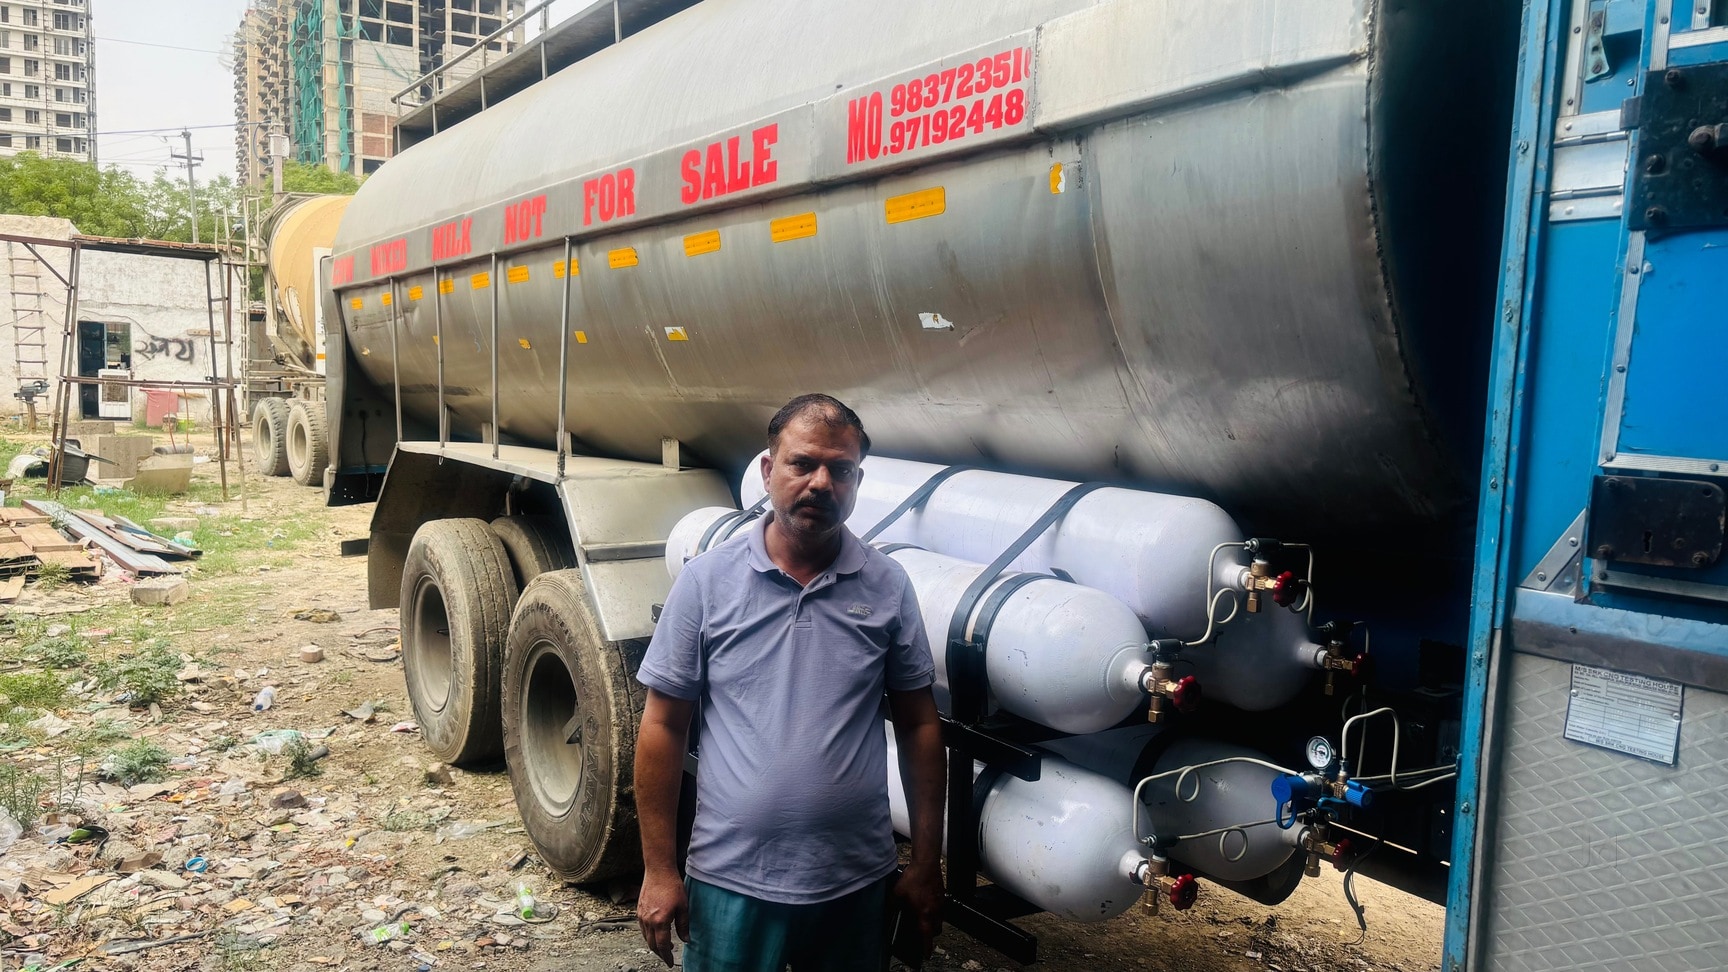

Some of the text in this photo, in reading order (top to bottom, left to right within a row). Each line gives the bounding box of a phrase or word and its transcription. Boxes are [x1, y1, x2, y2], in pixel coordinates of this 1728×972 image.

[847, 91, 889, 165] MO.
[890, 88, 1030, 155] 97192448
[370, 238, 407, 277] MIXED
[432, 217, 472, 262] MILK
[504, 196, 547, 246] NOT
[583, 167, 636, 226] FOR
[680, 123, 778, 205] SALE
[1620, 674, 1651, 687] TESTING
[1652, 681, 1680, 693] HOUSE
